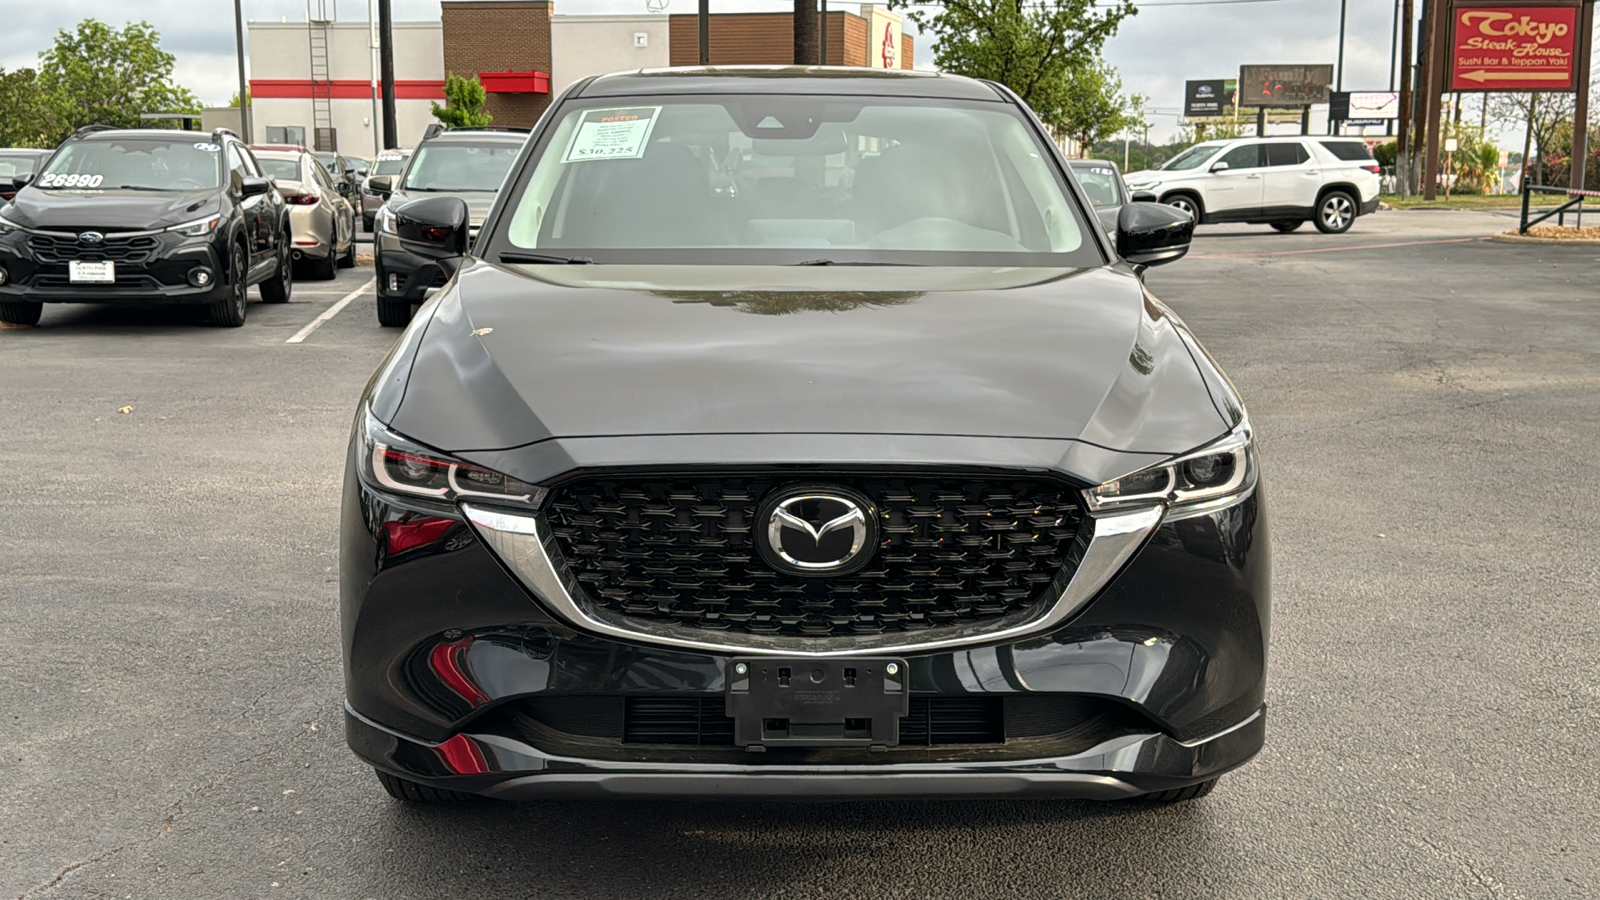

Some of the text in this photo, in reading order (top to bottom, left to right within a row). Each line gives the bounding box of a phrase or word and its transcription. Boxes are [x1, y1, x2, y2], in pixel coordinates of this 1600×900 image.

[1461, 11, 1568, 44] Tokyo
[1459, 37, 1570, 57] Steak House
[1458, 57, 1568, 67] Sushi Bar & Teppan Yaki
[39, 173, 104, 188] 26990
